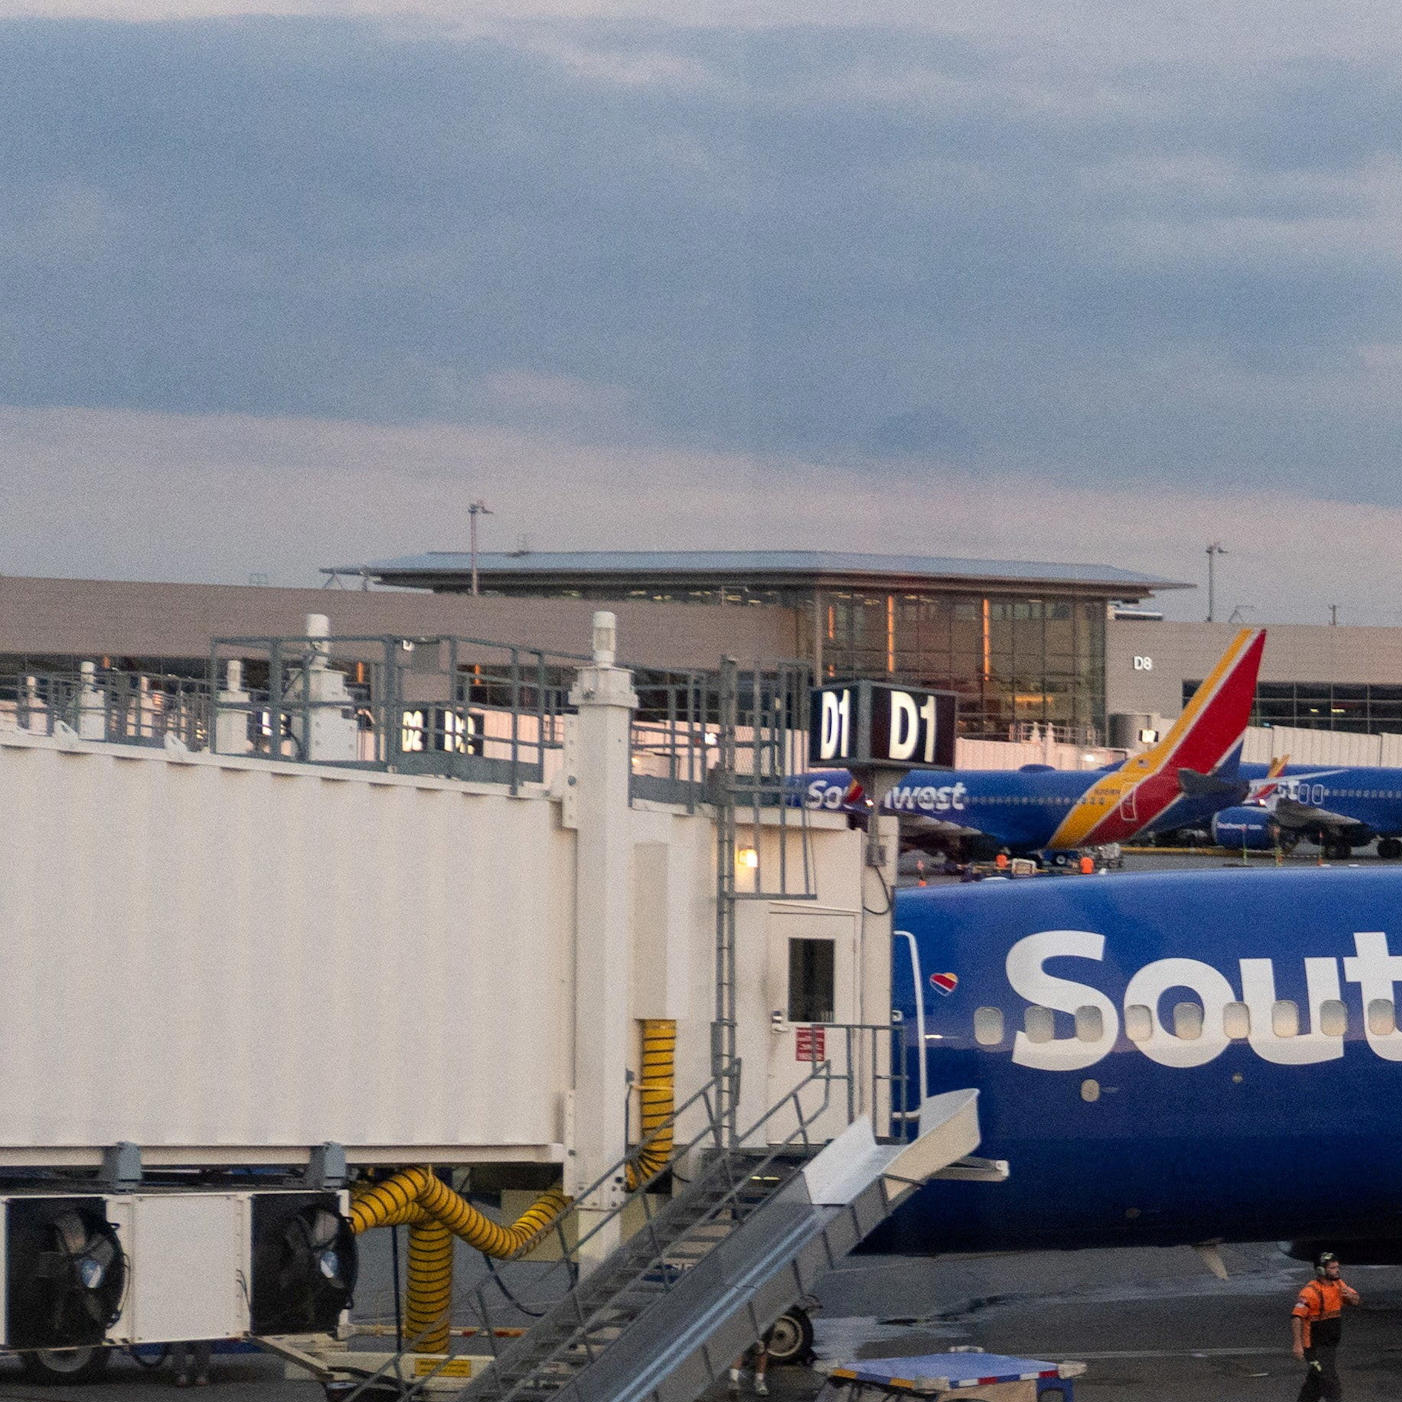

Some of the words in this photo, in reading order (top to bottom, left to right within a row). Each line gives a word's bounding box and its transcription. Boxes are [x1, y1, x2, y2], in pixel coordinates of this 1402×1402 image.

[1133, 656, 1152, 670] D8
[820, 689, 850, 760] D1
[888, 690, 937, 764] D1
